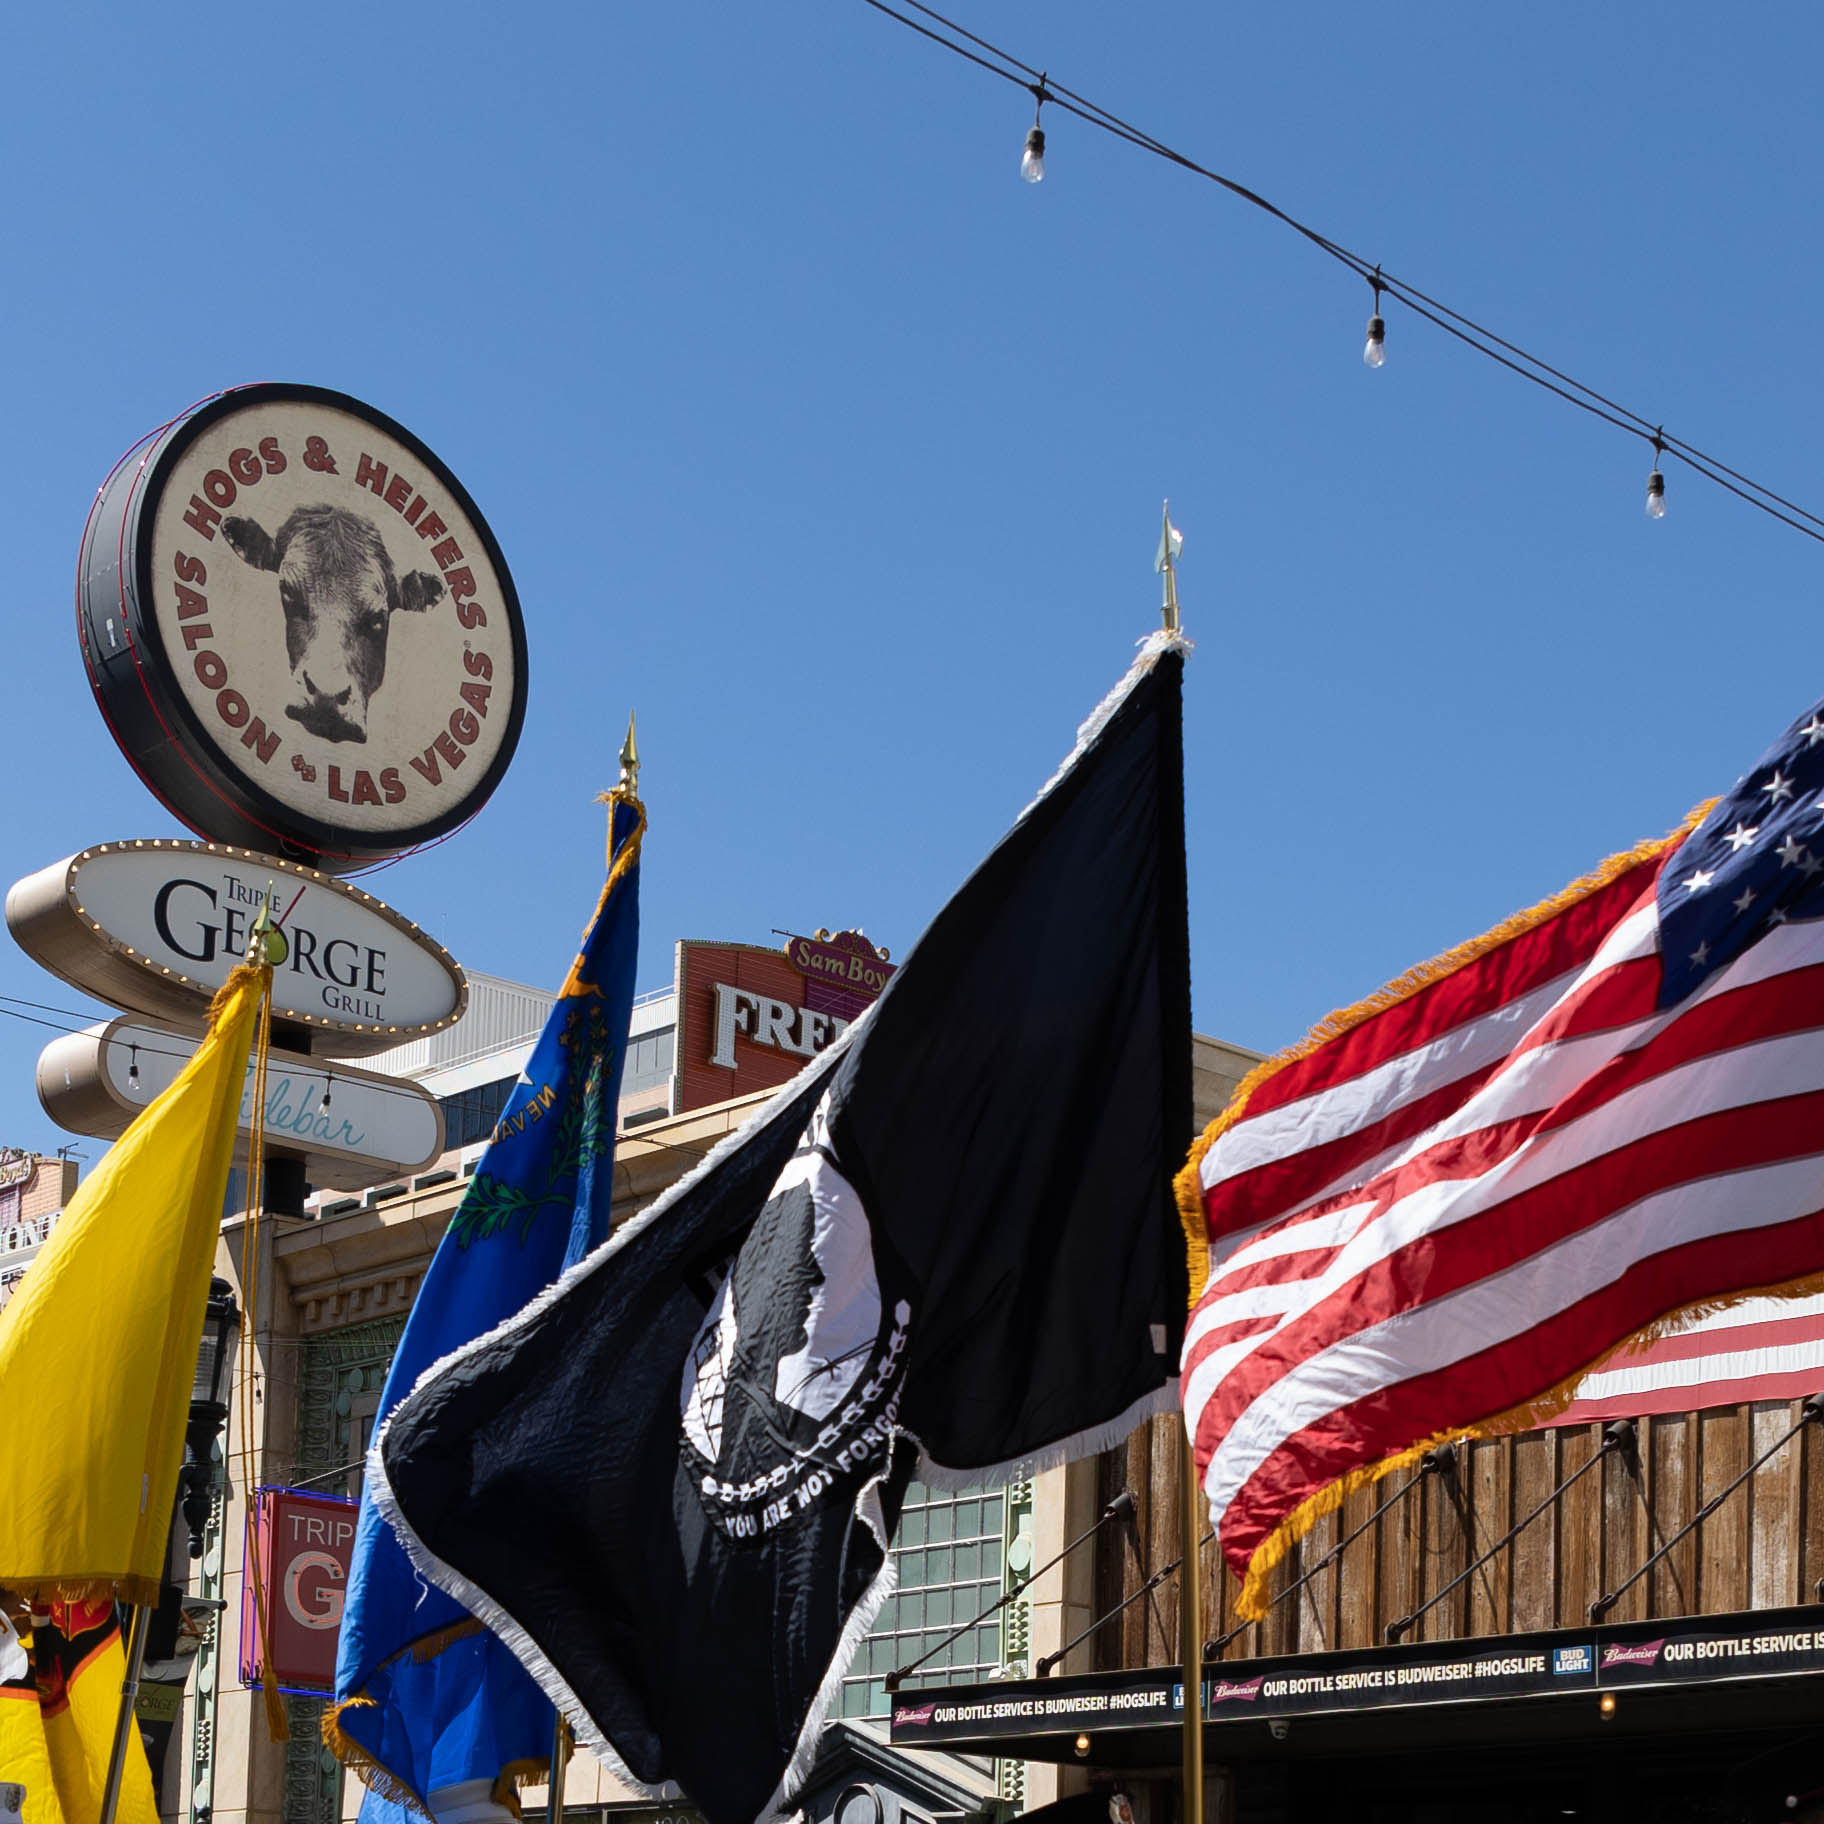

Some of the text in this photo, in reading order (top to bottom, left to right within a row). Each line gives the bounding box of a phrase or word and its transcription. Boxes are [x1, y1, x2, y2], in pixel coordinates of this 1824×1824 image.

[182, 435, 488, 632] HOGS & HEIFERS
[174, 549, 494, 807] SALOON LAS VEGAS
[796, 941, 893, 992] Sam Boy
[321, 985, 385, 1022] GRILL
[239, 1057, 365, 1146] idebar
[726, 1370, 908, 1538] YOU ARE NOT FORGO
[287, 1514, 354, 1547] TRIP
[1558, 1647, 1586, 1661] BUD
[1603, 1645, 1660, 1663] Budweiser
[1663, 1643, 1695, 1662] OUR
[1696, 1638, 1751, 1659] BOTTLE
[1752, 1633, 1812, 1655] SERVICE
[1263, 1655, 1545, 1697] OUR BOTTLE SERVICE IS BUDWEISER! #HOGSLIFE
[1555, 1658, 1590, 1673] LIGHT
[934, 1708, 957, 1723] OUR
[957, 1704, 993, 1721] BOTTLE
[993, 1701, 1034, 1718] SERVICE
[1034, 1700, 1045, 1715] IS
[1046, 1695, 1108, 1714] BUDWEISER!
[1109, 1691, 1167, 1710] #HOGSLIFE
[1214, 1682, 1259, 1699] Budweiser
